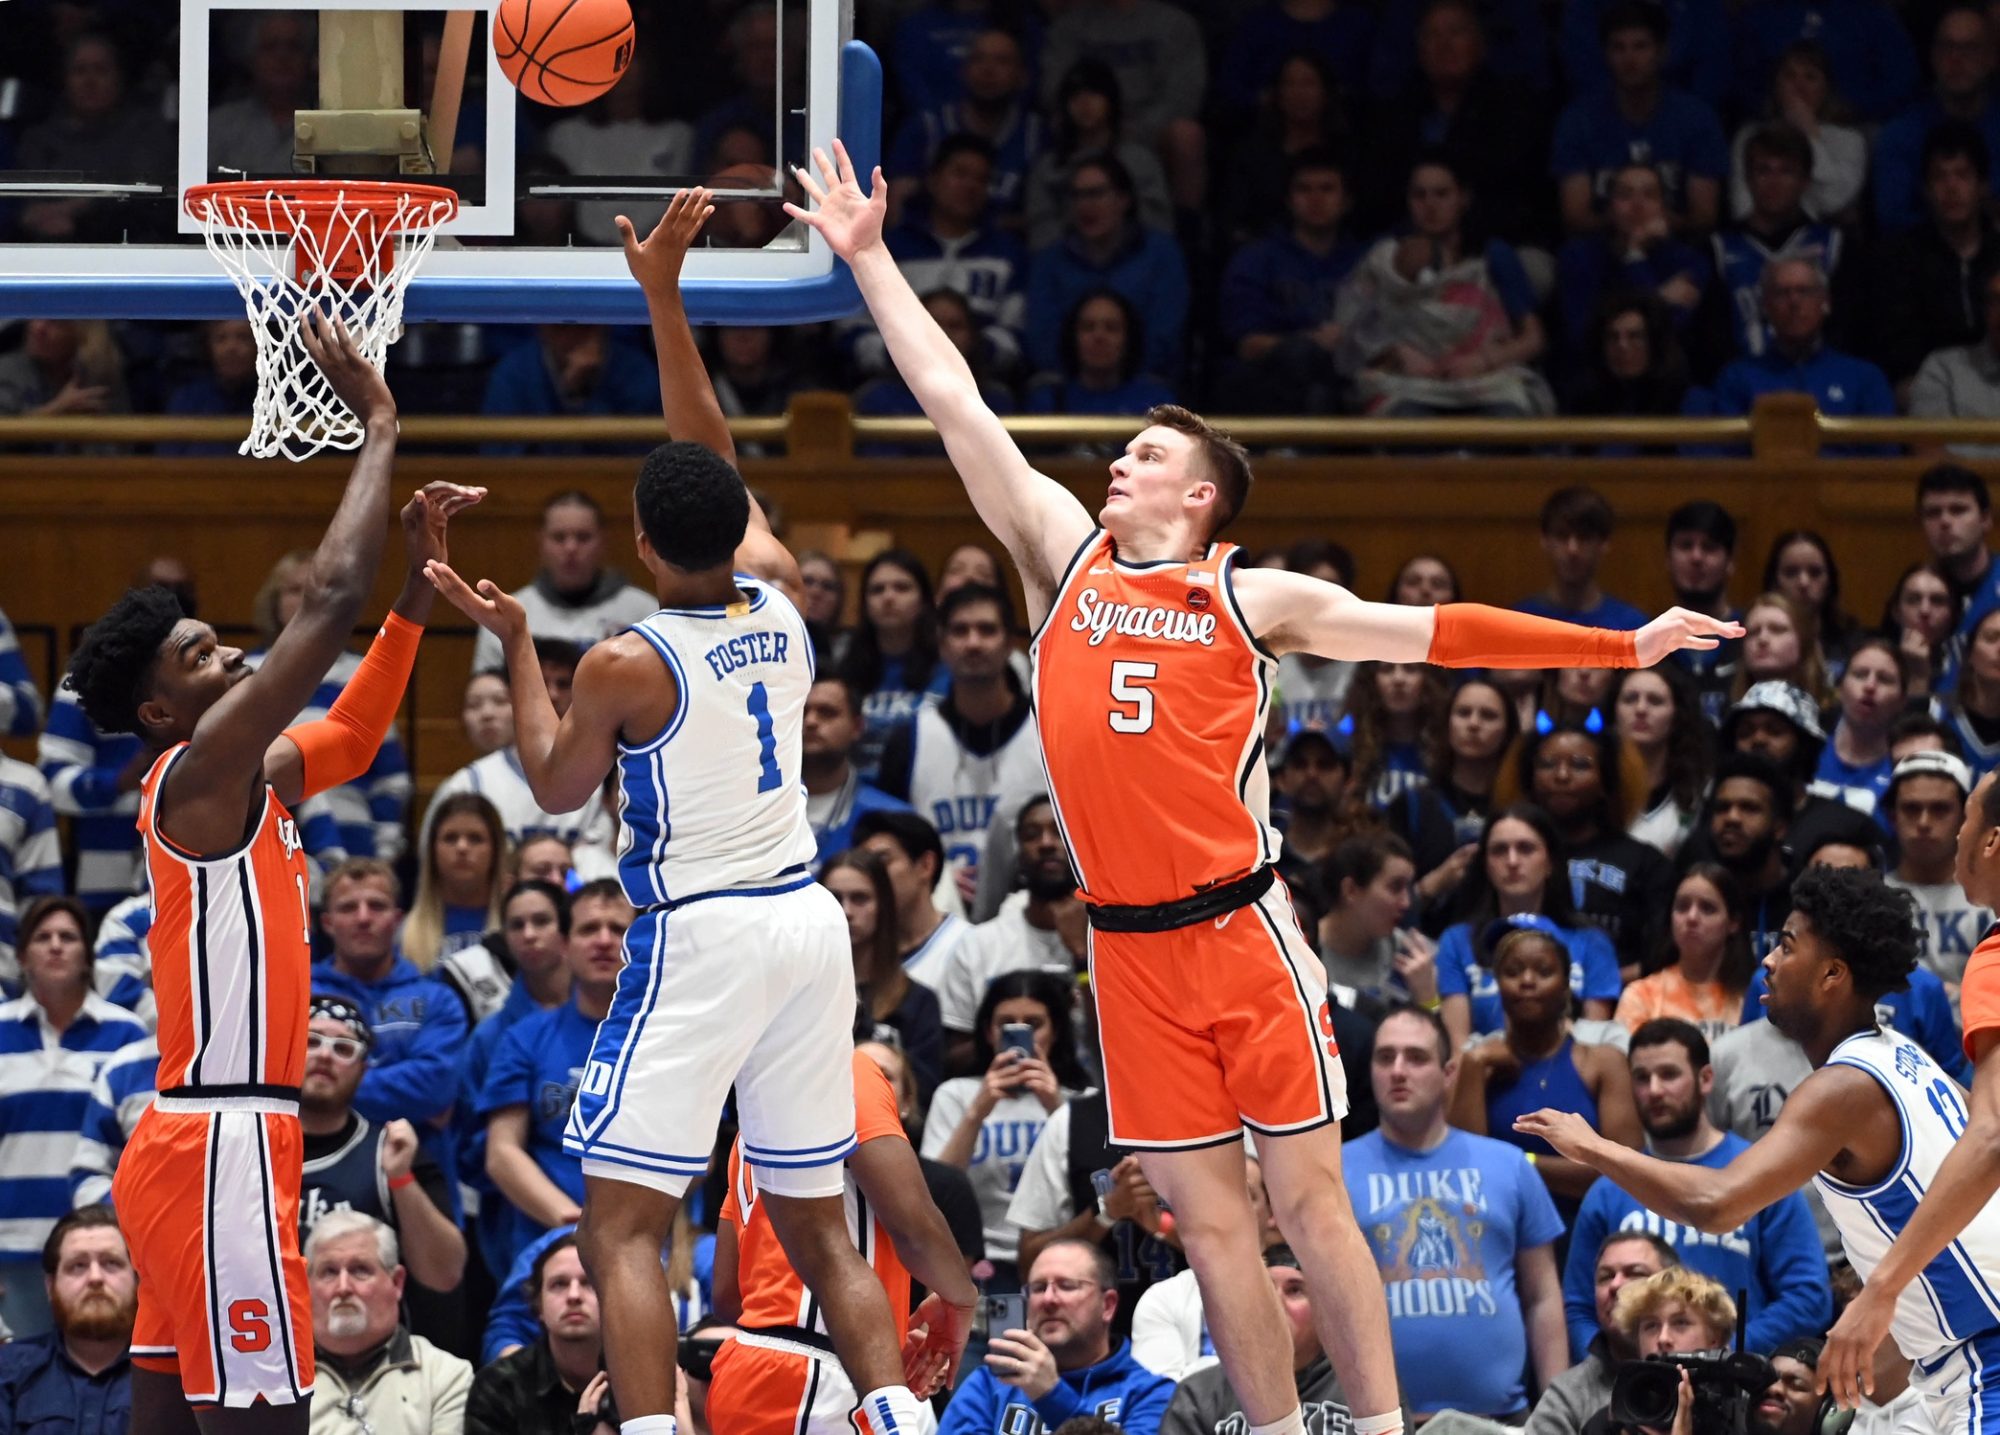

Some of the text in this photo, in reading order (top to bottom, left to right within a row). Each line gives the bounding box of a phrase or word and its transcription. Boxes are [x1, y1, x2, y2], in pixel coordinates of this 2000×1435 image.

[1070, 587, 1217, 647] Syracuse
[704, 631, 788, 682] FOSTER
[1108, 659, 1158, 734] 5
[746, 680, 783, 794] 1
[581, 1059, 613, 1096] D
[1368, 1167, 1488, 1215] DUKE
[228, 1298, 272, 1354] S
